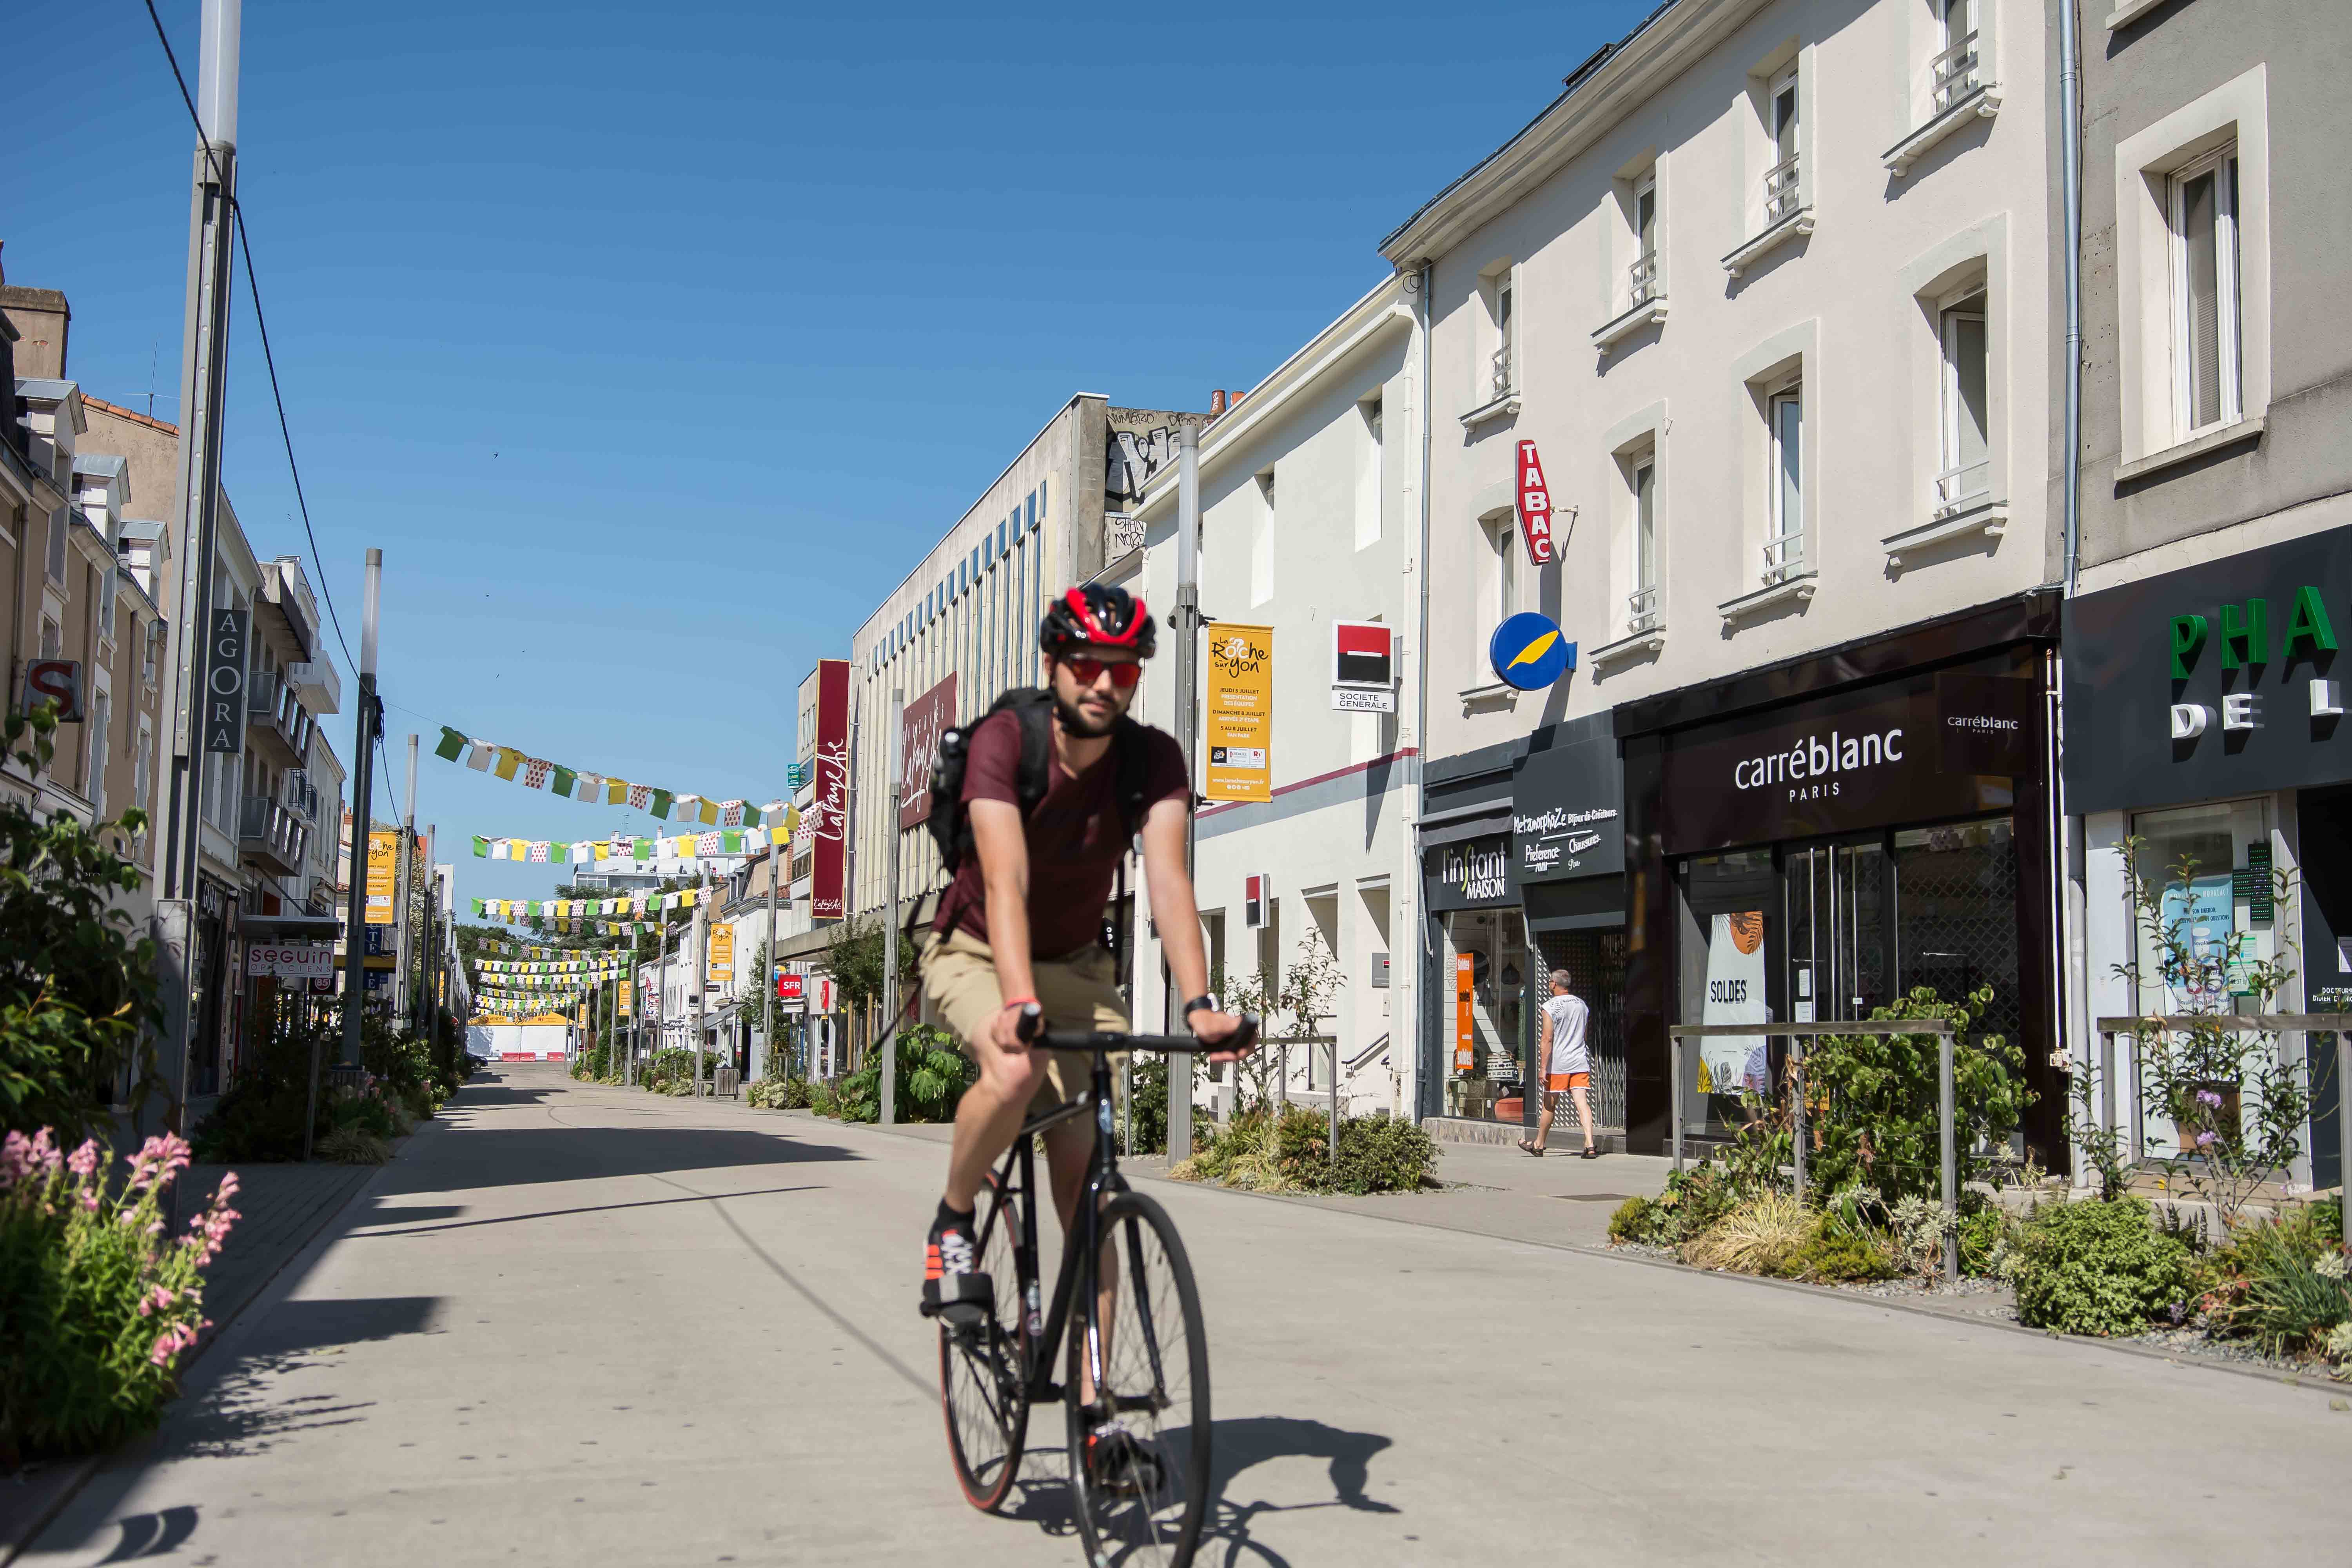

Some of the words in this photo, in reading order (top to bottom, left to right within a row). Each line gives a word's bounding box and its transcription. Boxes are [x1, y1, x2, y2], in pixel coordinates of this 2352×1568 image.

[1522, 444, 1550, 558] TABAC
[2170, 586, 2339, 679] PHA
[1211, 642, 1269, 661] Roche
[211, 613, 241, 748] AGORA
[1339, 693, 1379, 701] SOCIETE
[1339, 700, 1388, 709] GENERALE
[1948, 716, 2018, 730] carréblanc
[2171, 693, 2254, 739] DE
[1735, 729, 1902, 789] carréblanc
[1789, 782, 1839, 802] PARIS
[1467, 878, 1504, 899] MAISON
[250, 964, 331, 973] OPICIENS
[784, 981, 800, 989] SFR
[1710, 979, 1747, 1004] SOLDES
